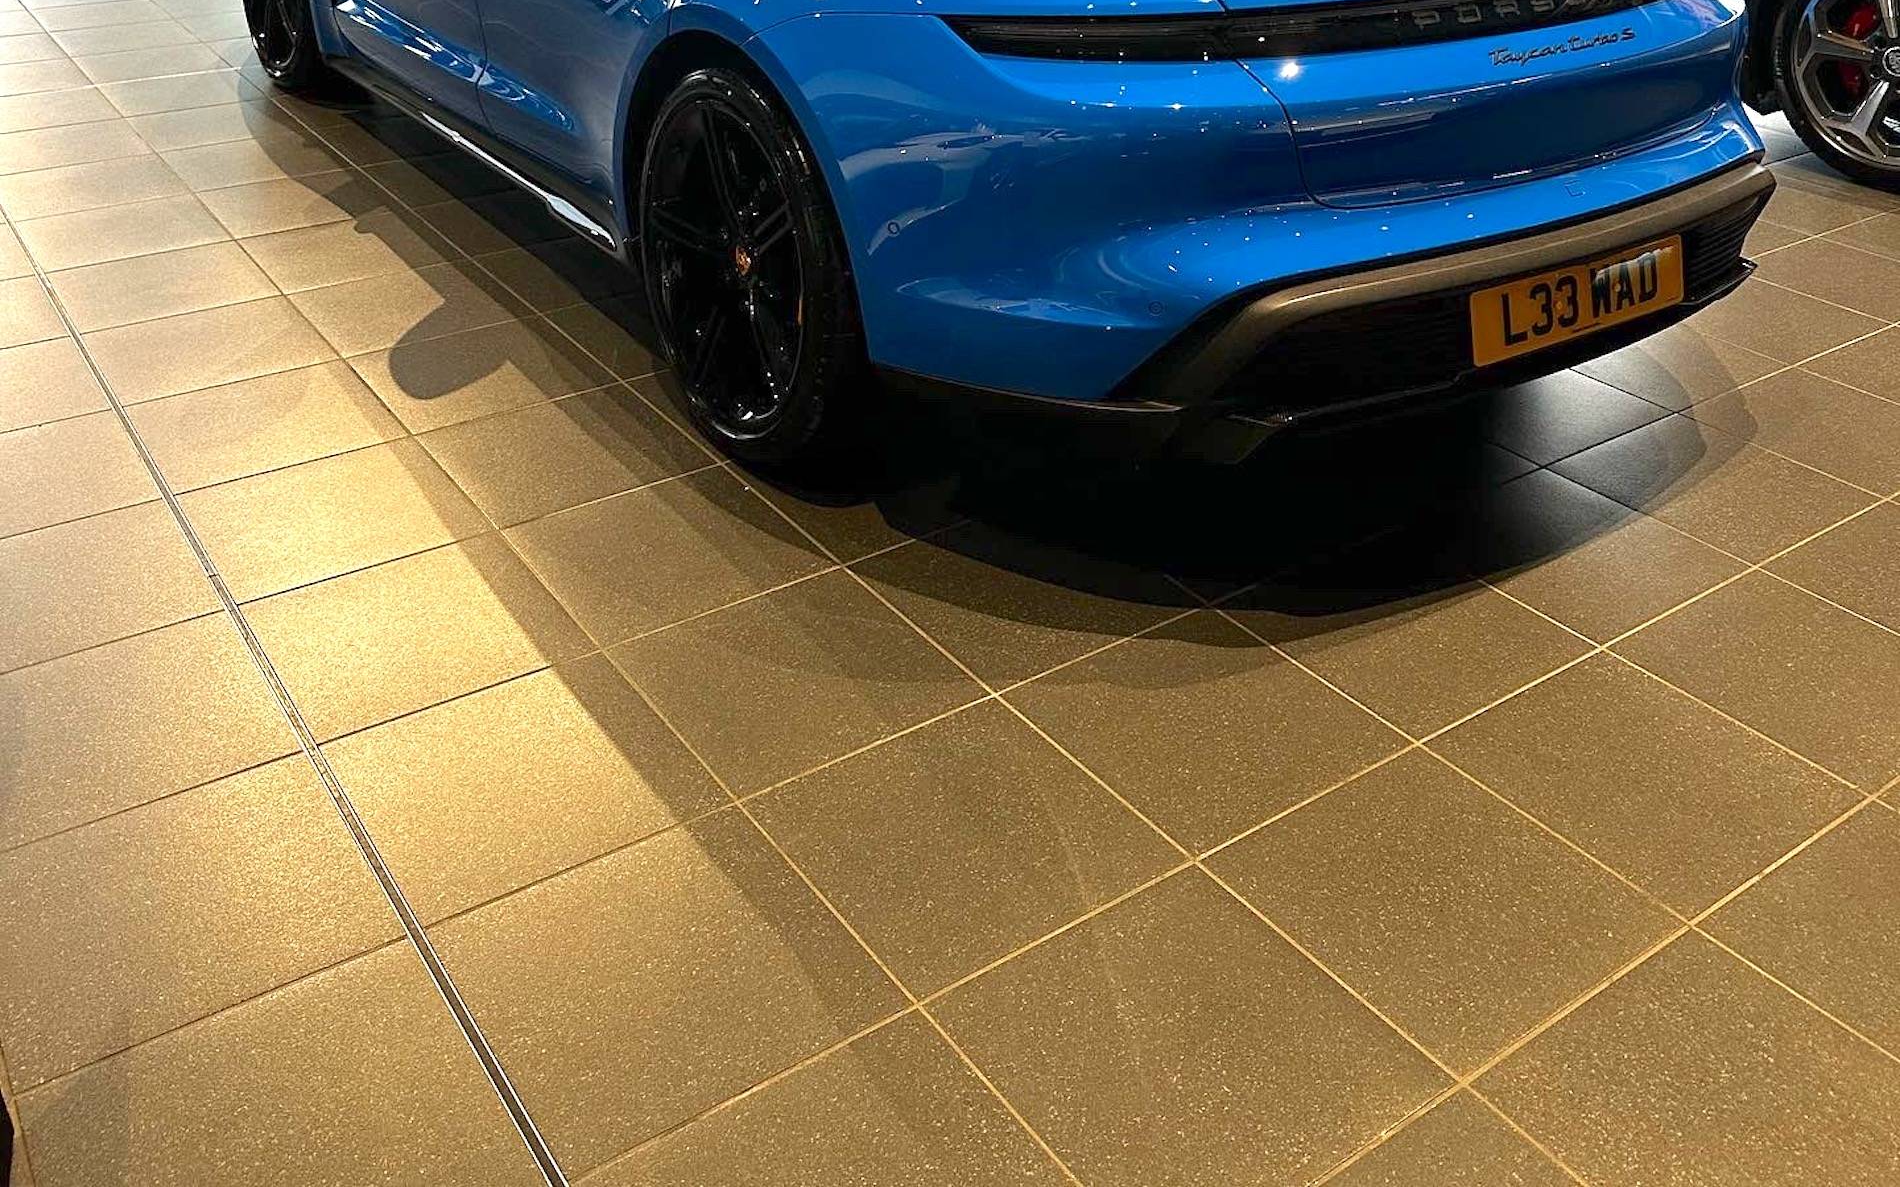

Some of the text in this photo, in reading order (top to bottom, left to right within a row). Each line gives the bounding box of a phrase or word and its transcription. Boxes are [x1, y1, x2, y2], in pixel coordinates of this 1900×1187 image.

[1488, 43, 1567, 67] Taycan
[1618, 26, 1637, 42] S
[1500, 255, 1658, 347] L33 WAD
